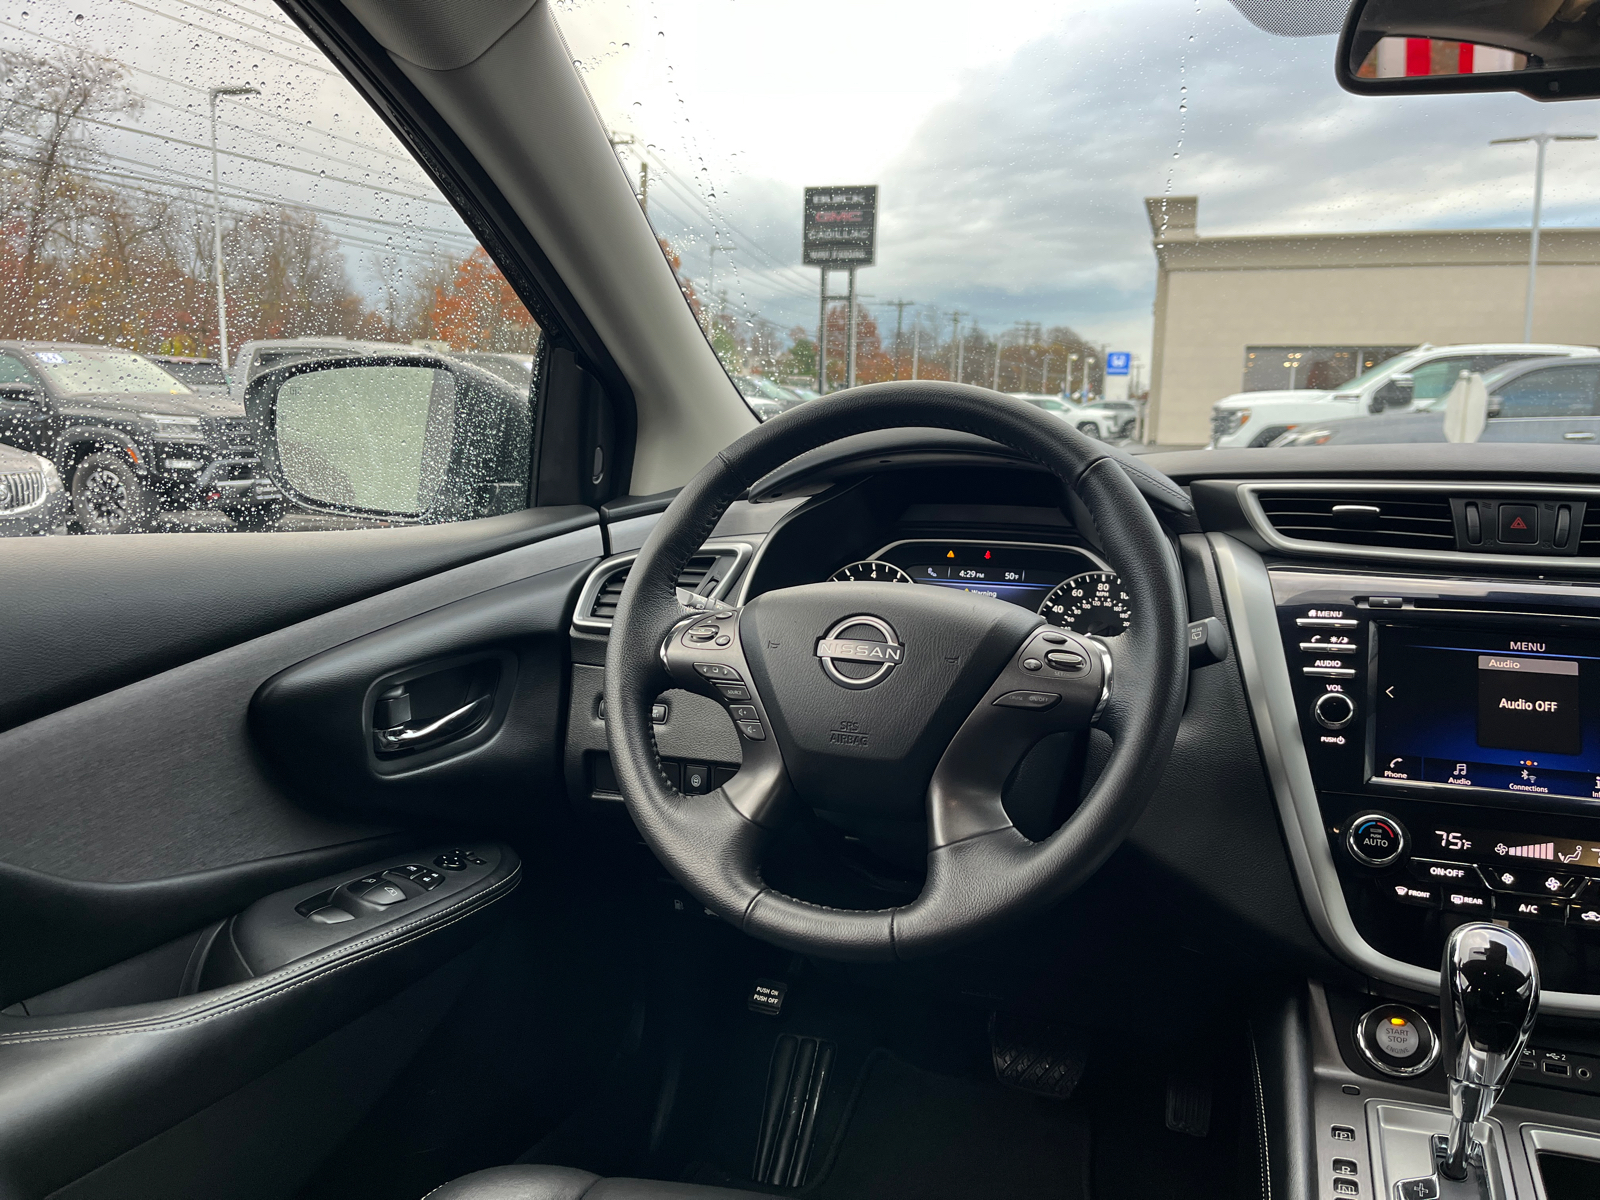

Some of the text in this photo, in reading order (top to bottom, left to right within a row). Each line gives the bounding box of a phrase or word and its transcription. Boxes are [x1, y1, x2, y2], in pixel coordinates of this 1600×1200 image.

[813, 194, 866, 204] BUICK
[815, 211, 863, 222] GMC
[808, 230, 869, 239] CADILLAC
[870, 570, 877, 579] 4
[959, 570, 976, 578] 4:29
[1097, 583, 1109, 591] 80
[1071, 589, 1083, 597] 60
[1051, 605, 1064, 613] 40
[1317, 610, 1343, 618] MENU
[820, 643, 901, 660] NISSAN
[1509, 641, 1546, 652] MENU
[1314, 660, 1342, 668] AUDIO
[1488, 659, 1520, 669] Audio
[1326, 684, 1344, 692] VOL
[1499, 698, 1558, 712] Audio OFF
[840, 720, 860, 732] SRS
[830, 733, 869, 747] AIRBAG
[1384, 770, 1408, 779] Phone
[1447, 777, 1472, 786] Audio
[1508, 783, 1549, 794] Connections
[1363, 837, 1389, 848] AUTO
[1408, 889, 1431, 899] FRONT
[1463, 896, 1483, 906] REAR
[1518, 903, 1539, 914] A/C
[756, 986, 770, 994] PUSH
[753, 994, 767, 1002] PUSH
[1385, 1027, 1410, 1037] START
[1387, 1035, 1408, 1044] STOP
[1385, 1044, 1410, 1054] ENGINE
